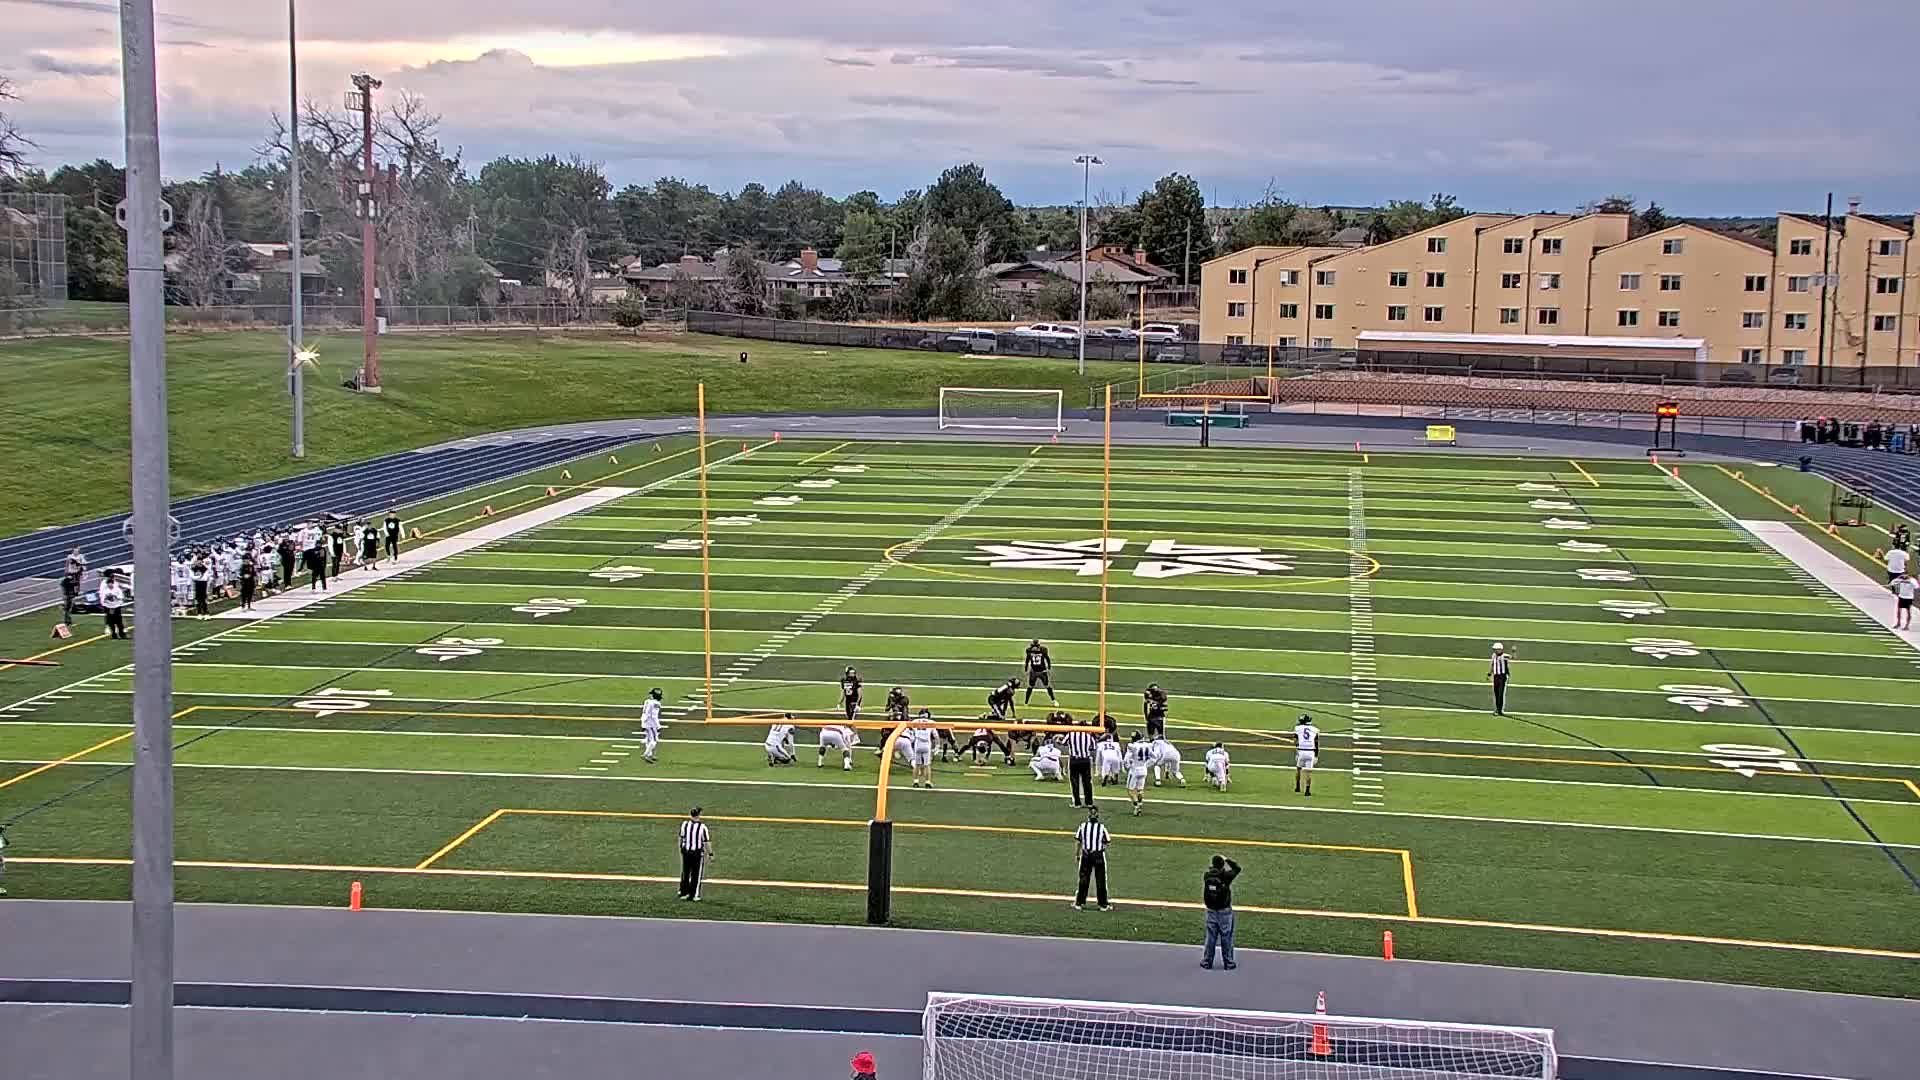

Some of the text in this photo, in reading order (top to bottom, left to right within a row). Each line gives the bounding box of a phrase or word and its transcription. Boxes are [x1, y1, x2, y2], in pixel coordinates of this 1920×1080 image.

[511, 597, 588, 613] 30
[414, 637, 505, 656] 20
[1625, 637, 1701, 656] 30
[293, 687, 394, 710] 10
[1658, 684, 1750, 708] 20
[1303, 727, 1310, 740] 5
[1700, 743, 1802, 772] 10
